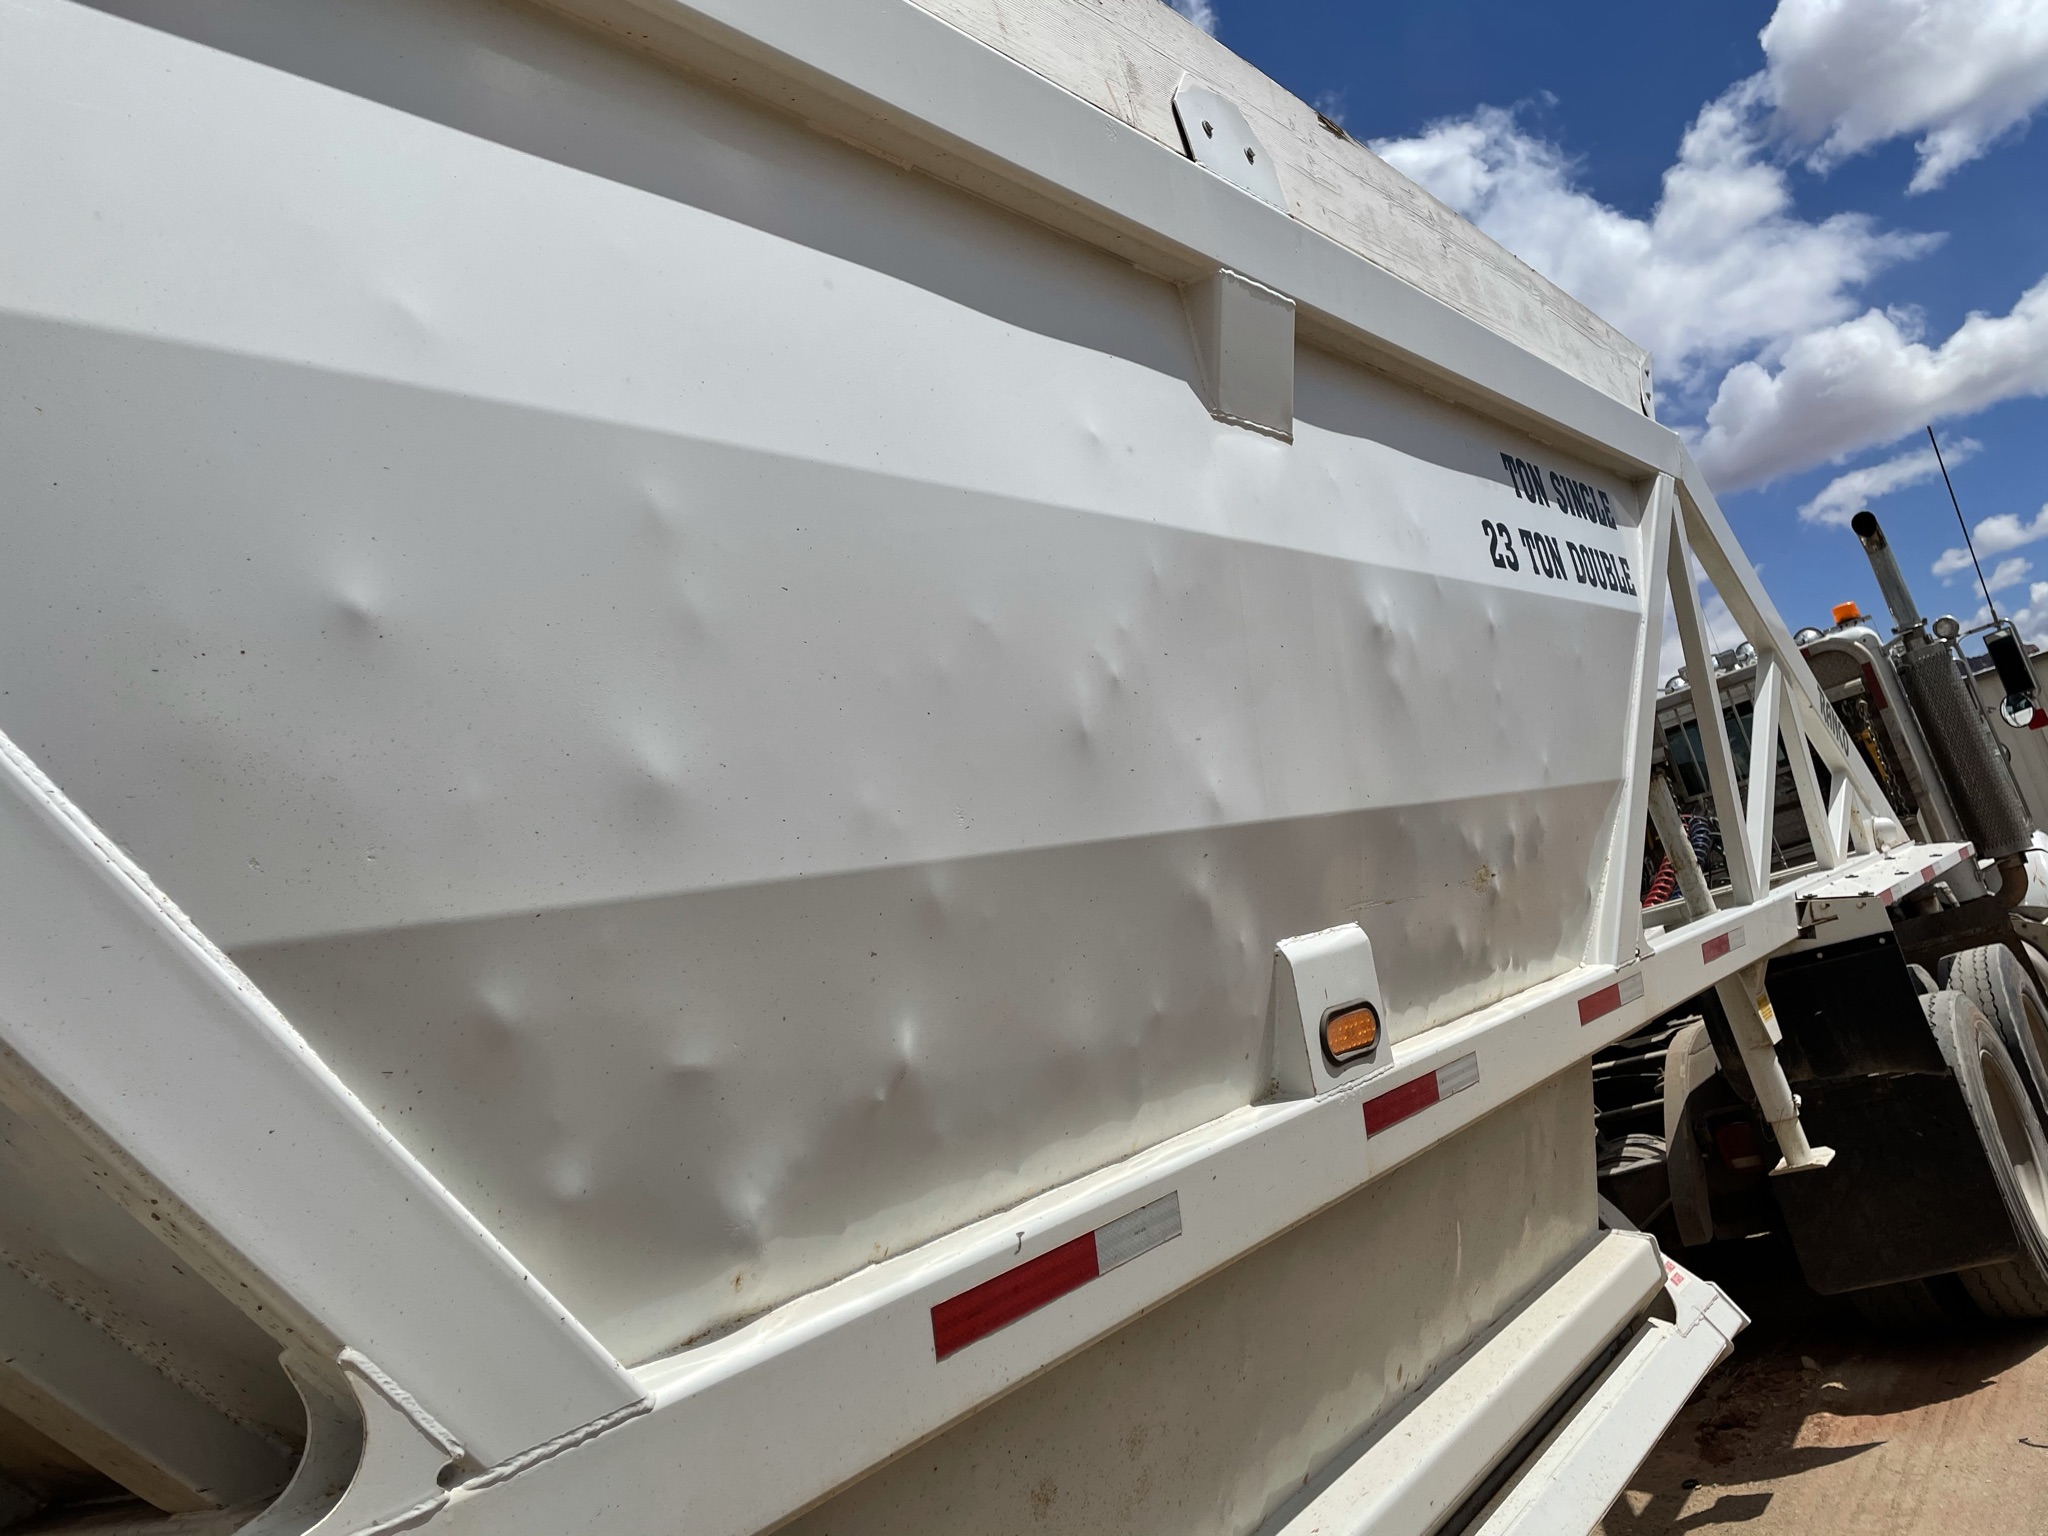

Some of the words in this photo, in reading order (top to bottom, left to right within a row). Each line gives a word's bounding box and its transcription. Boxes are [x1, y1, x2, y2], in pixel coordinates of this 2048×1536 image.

[1500, 452, 1550, 508] TON
[1550, 471, 1617, 530] SINGLE
[1481, 519, 1519, 572] 23
[1518, 528, 1568, 580] TON
[1566, 541, 1637, 596] DOUBLE
